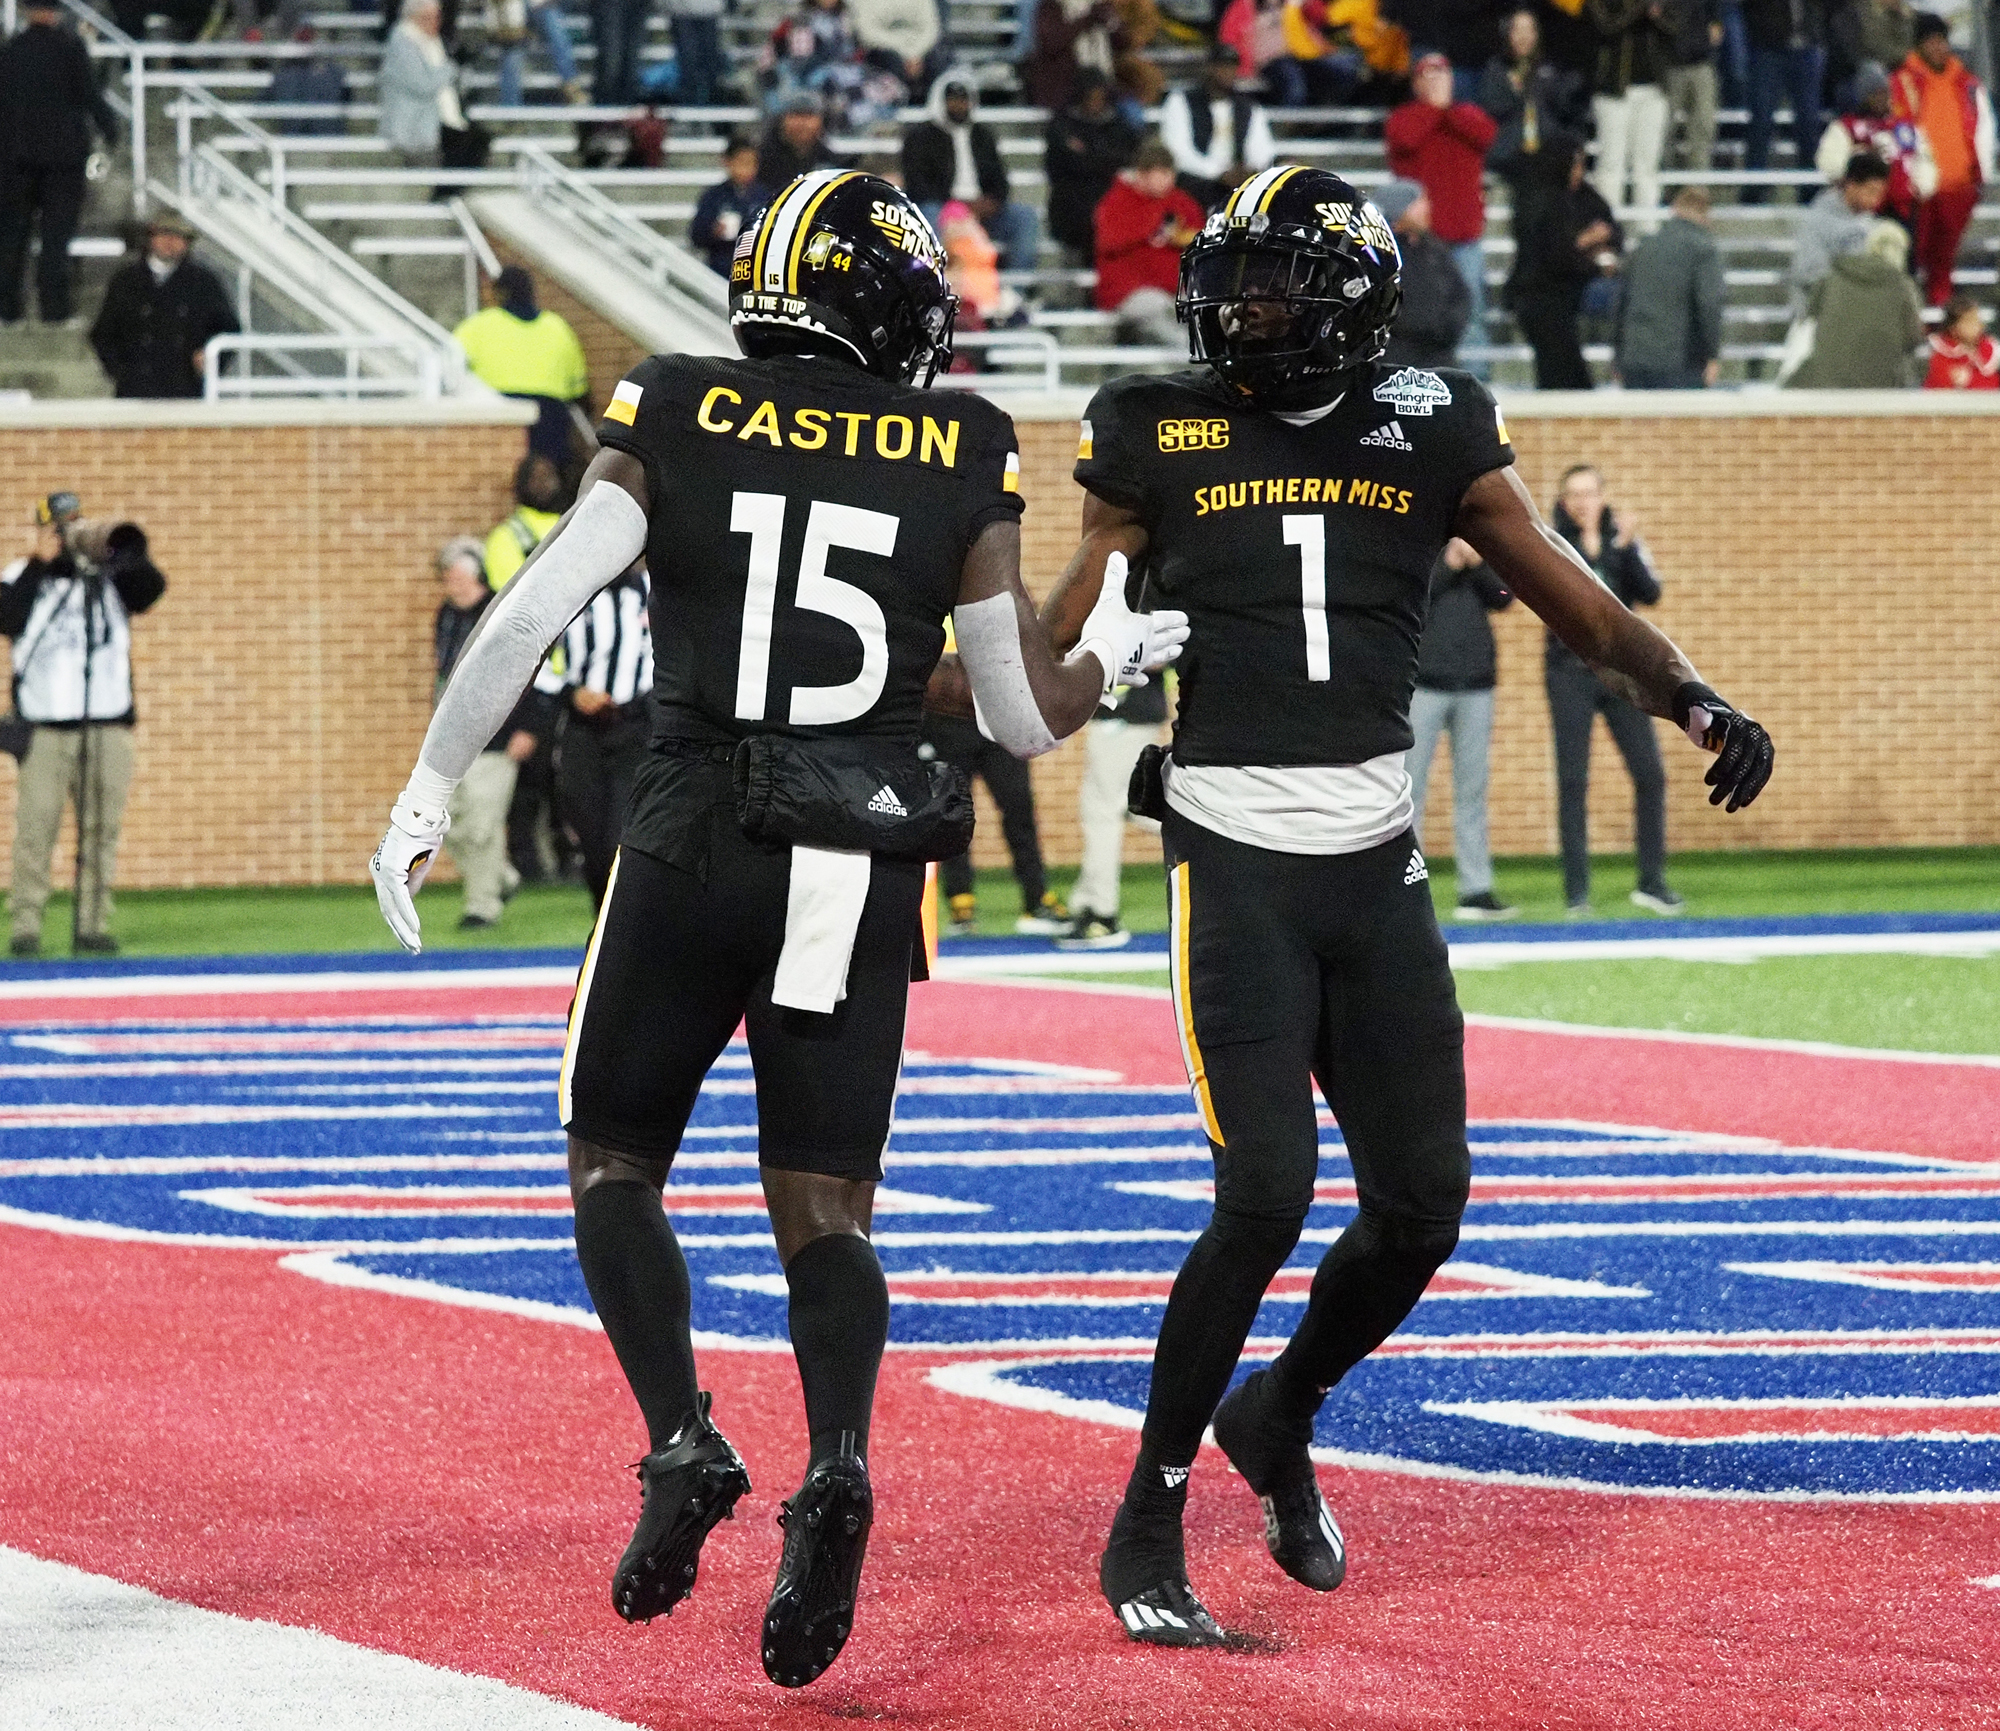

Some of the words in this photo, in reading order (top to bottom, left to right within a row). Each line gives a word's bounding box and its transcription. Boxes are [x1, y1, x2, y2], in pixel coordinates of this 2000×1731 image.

[832, 252, 851, 272] 44
[769, 274, 779, 285] 15
[742, 295, 755, 309] TO
[758, 296, 778, 310] THE
[782, 298, 806, 315] TOP
[1376, 391, 1450, 405] lendingtree
[1398, 405, 1430, 414] BOWL
[697, 386, 960, 468] CASTON
[1157, 418, 1229, 452] SBC
[1360, 435, 1413, 451] adidas
[1195, 478, 1343, 516] SOUTHERN
[1348, 478, 1413, 514] MISS
[1282, 514, 1330, 681] 1
[730, 491, 900, 725] 15
[868, 801, 907, 817] adidas
